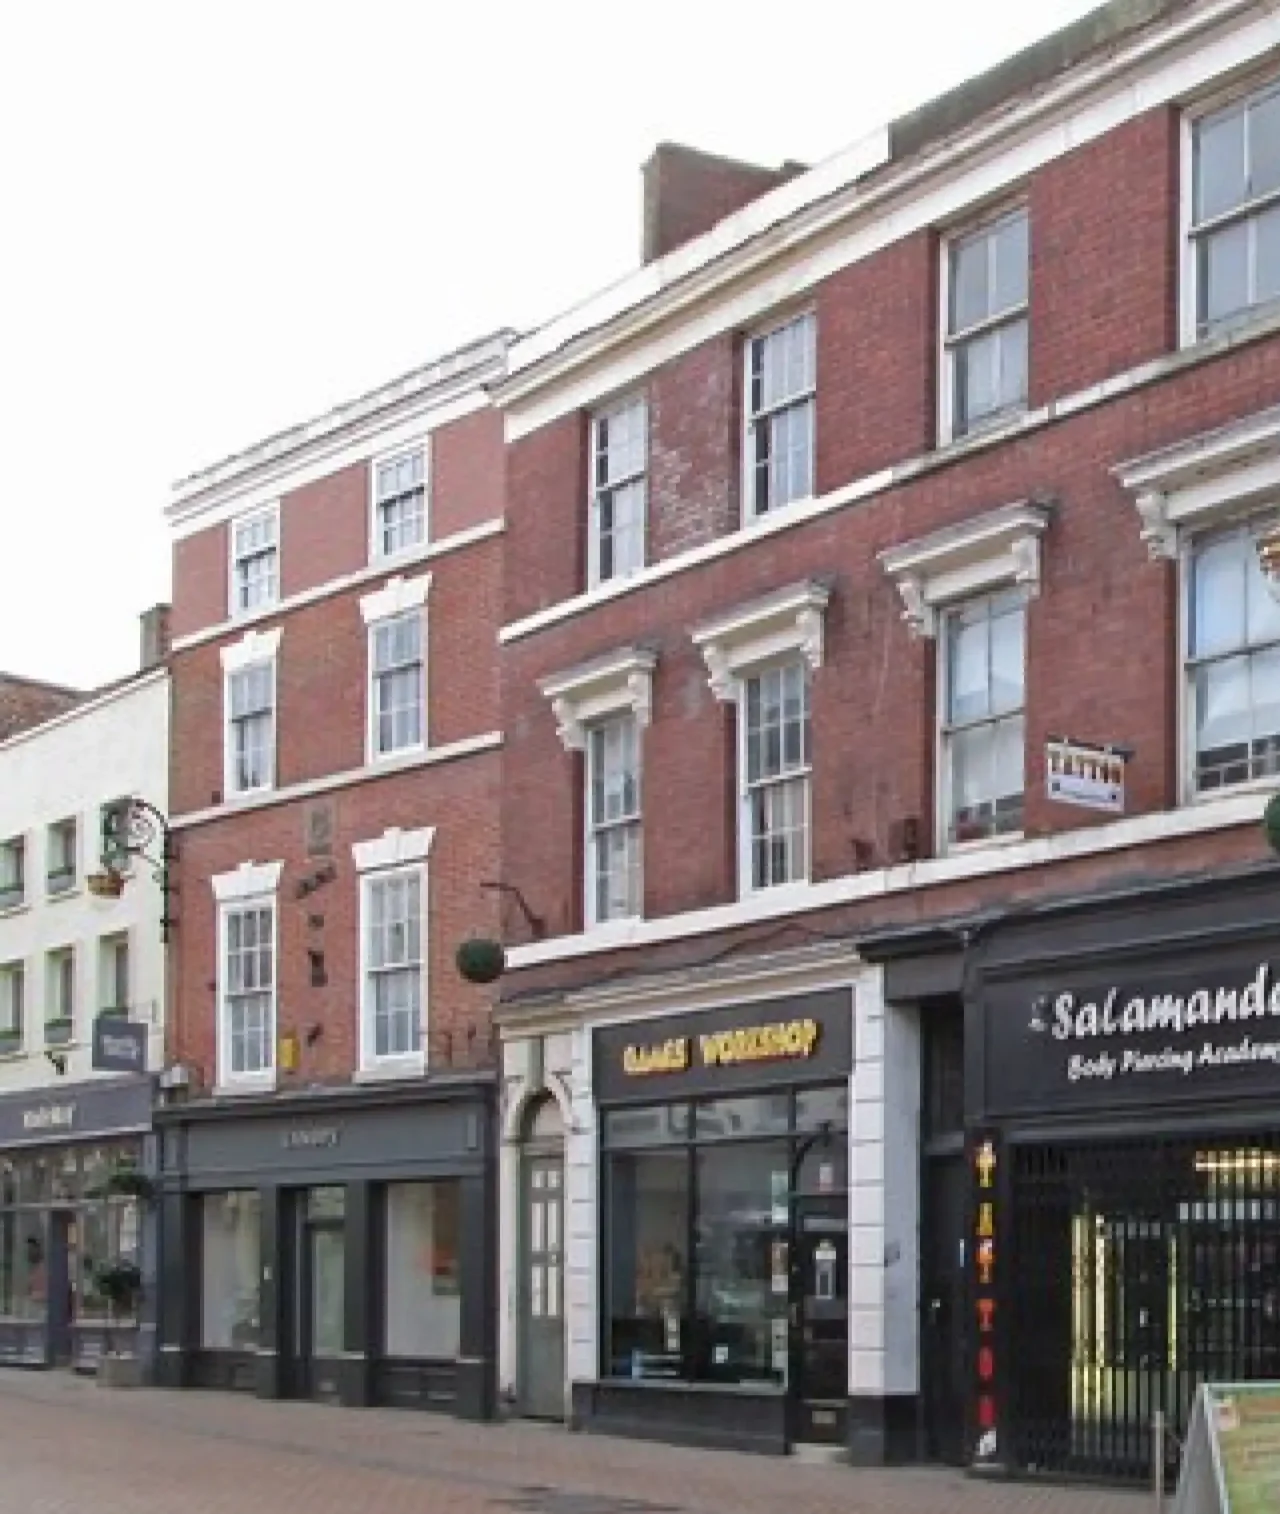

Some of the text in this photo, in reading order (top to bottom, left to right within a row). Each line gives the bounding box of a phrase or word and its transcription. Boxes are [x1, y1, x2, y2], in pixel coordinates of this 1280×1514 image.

[623, 1018, 818, 1075] GAMES WORKSHOP
[1066, 1053, 1116, 1082] Body
[1120, 1046, 1194, 1075] Piercing
